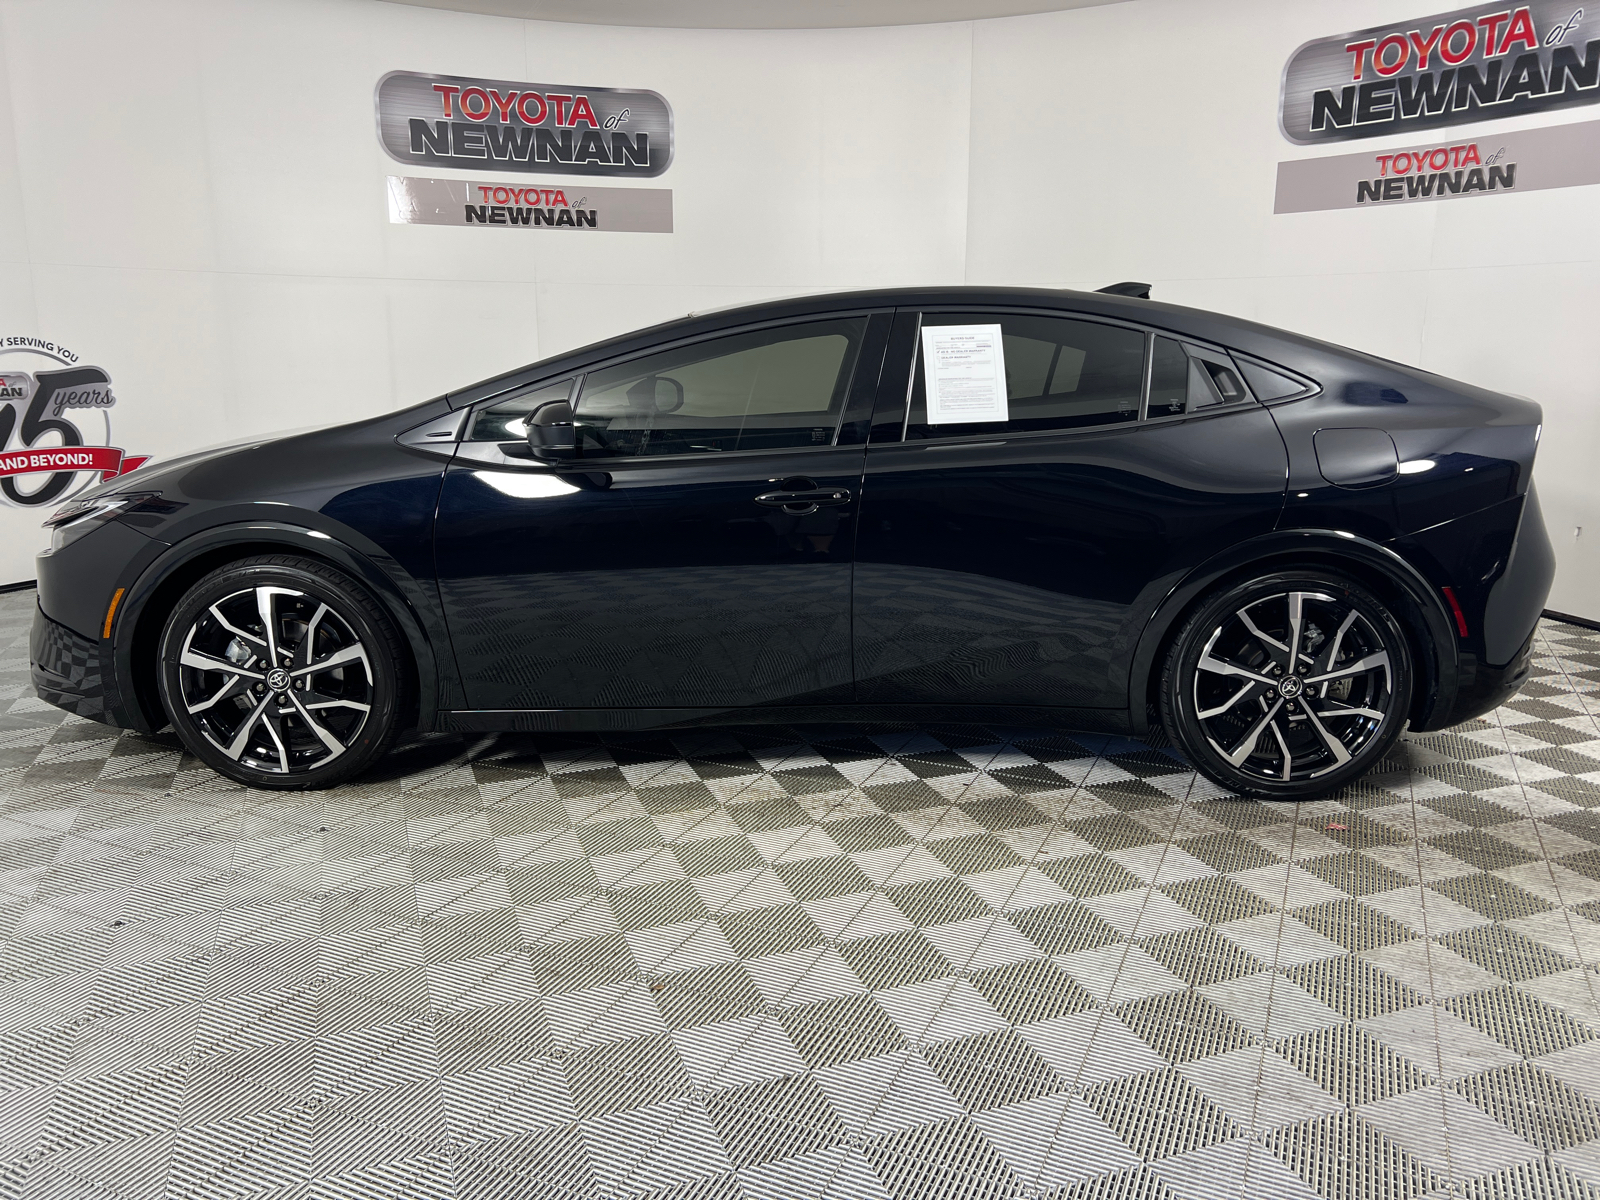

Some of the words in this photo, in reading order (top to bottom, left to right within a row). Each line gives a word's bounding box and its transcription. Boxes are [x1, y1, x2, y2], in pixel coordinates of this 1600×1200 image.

[1346, 6, 1539, 81] TOYOTA
[1544, 8, 1584, 47] of
[1309, 39, 1600, 132] NEWNAN
[431, 83, 599, 128] TOYOTA
[602, 108, 630, 130] of
[408, 117, 650, 166] NEWNAN
[1376, 143, 1481, 177] TOYOTA
[1485, 147, 1505, 165] of
[477, 186, 569, 207] TOYOTA
[571, 196, 587, 209] of
[1356, 162, 1517, 204] NEWNAN
[464, 204, 597, 229] NEWNAN
[7, 337, 54, 351] SERVING
[57, 345, 79, 363] YOU
[53, 388, 114, 417] years
[30, 454, 93, 467] BEYOND!
